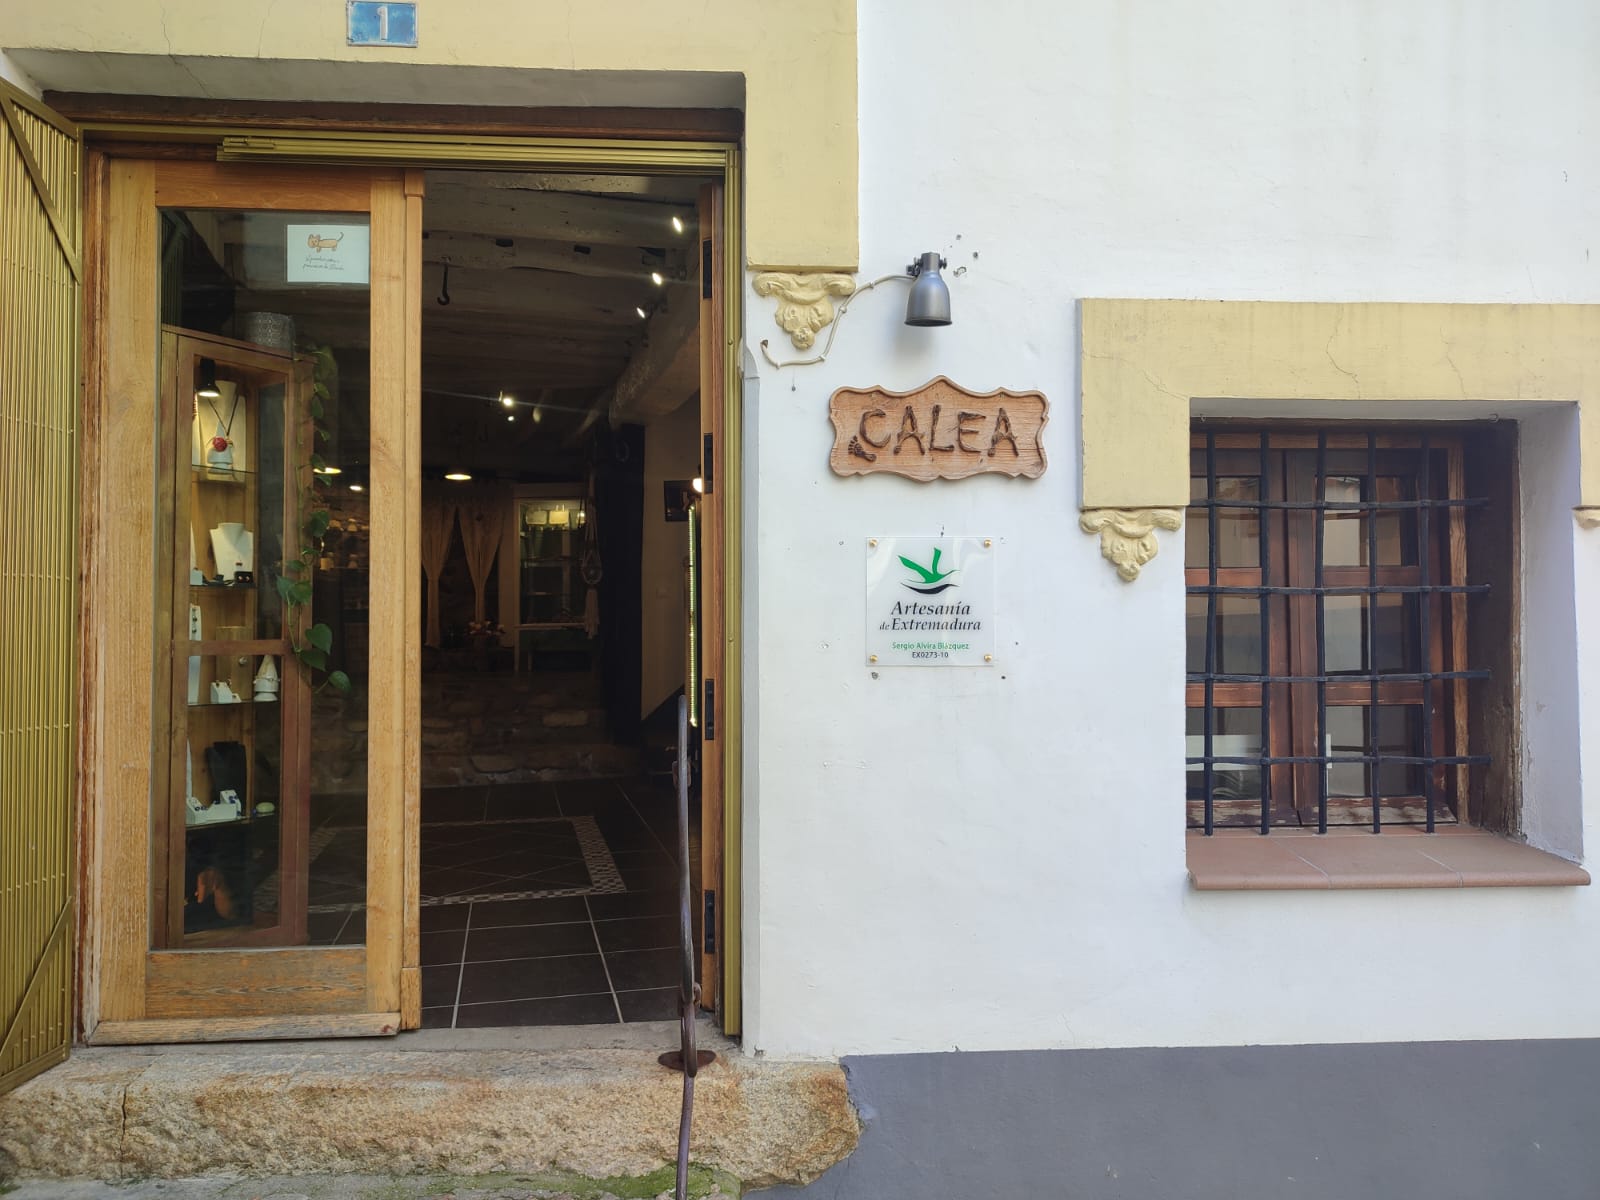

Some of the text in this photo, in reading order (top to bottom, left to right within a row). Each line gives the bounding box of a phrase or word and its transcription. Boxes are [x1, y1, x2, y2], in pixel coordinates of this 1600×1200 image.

[376, 6, 388, 41] 1
[858, 404, 1019, 458] CALEA
[891, 601, 971, 615] Artesanía
[879, 617, 982, 631] de Extremadura
[892, 642, 915, 651] Sergio
[916, 642, 936, 650] Alvira
[911, 651, 949, 659] EX0273-10
